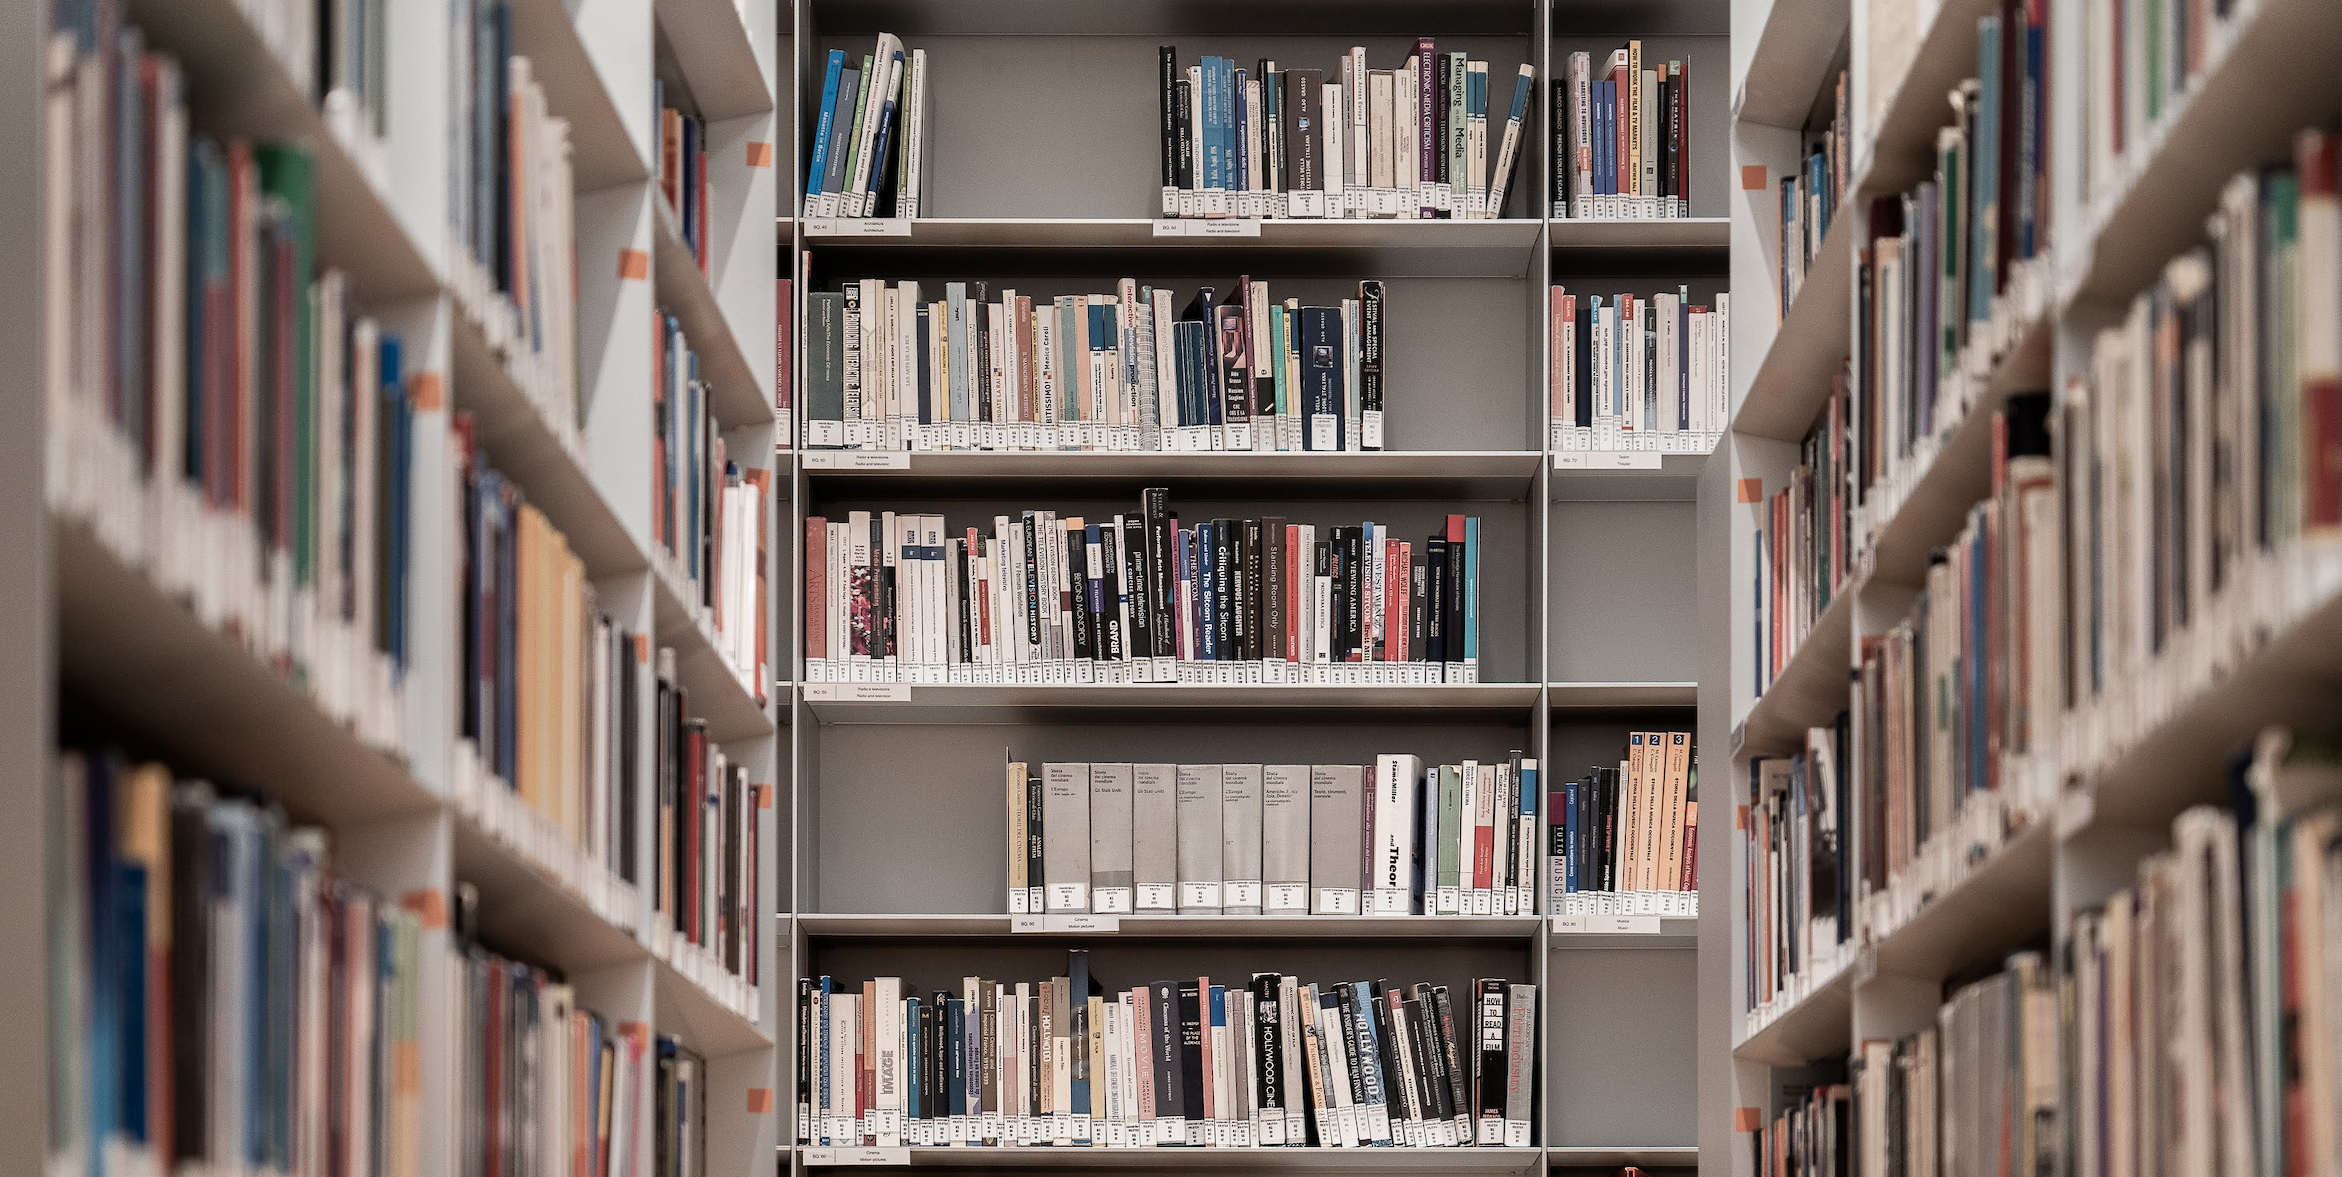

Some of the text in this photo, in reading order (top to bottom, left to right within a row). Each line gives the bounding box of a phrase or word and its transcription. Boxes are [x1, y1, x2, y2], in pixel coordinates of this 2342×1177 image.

[1423, 52, 1431, 92] ELECTRONIC
[1632, 60, 1637, 68] TO
[1452, 58, 1464, 106] Managing
[1423, 93, 1431, 116] MEDIA
[1455, 128, 1464, 158] Media
[846, 314, 860, 420] PRODUCING INTERACTIVE TELEVISIO
[1048, 536, 1056, 563] TELEVISION
[1270, 547, 1278, 581] Standing
[809, 570, 822, 604] ARTS
[1027, 558, 1036, 608] TELEVISION
[1133, 552, 1146, 627] prime-time television
[1203, 572, 1211, 588] The
[1218, 546, 1228, 640] Critiquing the Sitcom
[1234, 571, 1242, 600] NERVOUS
[1074, 573, 1085, 646] BEYOND MONOPOLY
[1270, 611, 1278, 629] Only
[1109, 621, 1118, 652] BRAND
[1205, 624, 1213, 654] Reader
[1634, 736, 1640, 745] 1
[1651, 735, 1659, 745] 2
[1675, 735, 1683, 744] 3
[1389, 847, 1398, 886] Theor
[1555, 859, 1563, 894] MUSIC
[1042, 1015, 1051, 1062] HOLLYWOOD
[1140, 1033, 1148, 1077] MOVIE
[1264, 1027, 1273, 1084] HOLLYWOOD
[1510, 1007, 1525, 1093] Film Industry
[1343, 1014, 1352, 1039] INSIDER'S
[1354, 1080, 1363, 1102] FINANCE
